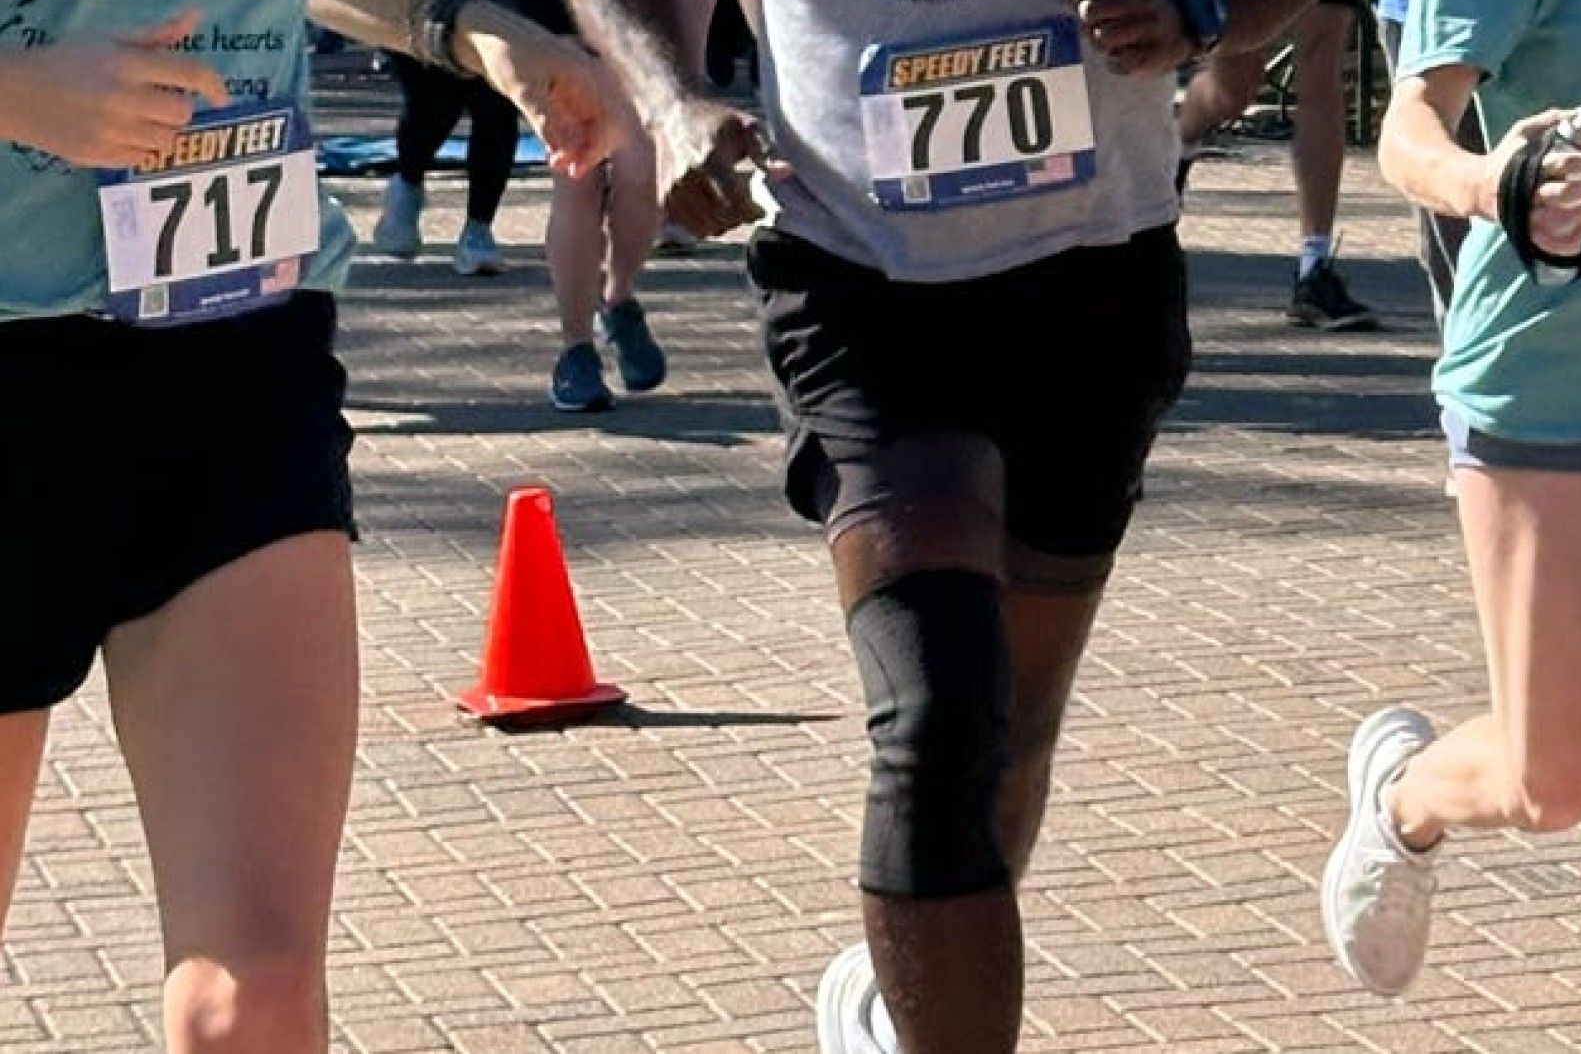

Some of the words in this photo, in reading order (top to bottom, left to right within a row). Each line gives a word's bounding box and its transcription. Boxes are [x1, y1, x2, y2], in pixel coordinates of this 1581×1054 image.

[211, 23, 286, 53] hearts
[893, 47, 985, 85] SPEEDY
[988, 38, 1044, 71] FEET
[234, 117, 286, 156] FEET
[904, 77, 1053, 170] 770
[151, 163, 284, 277] 717
